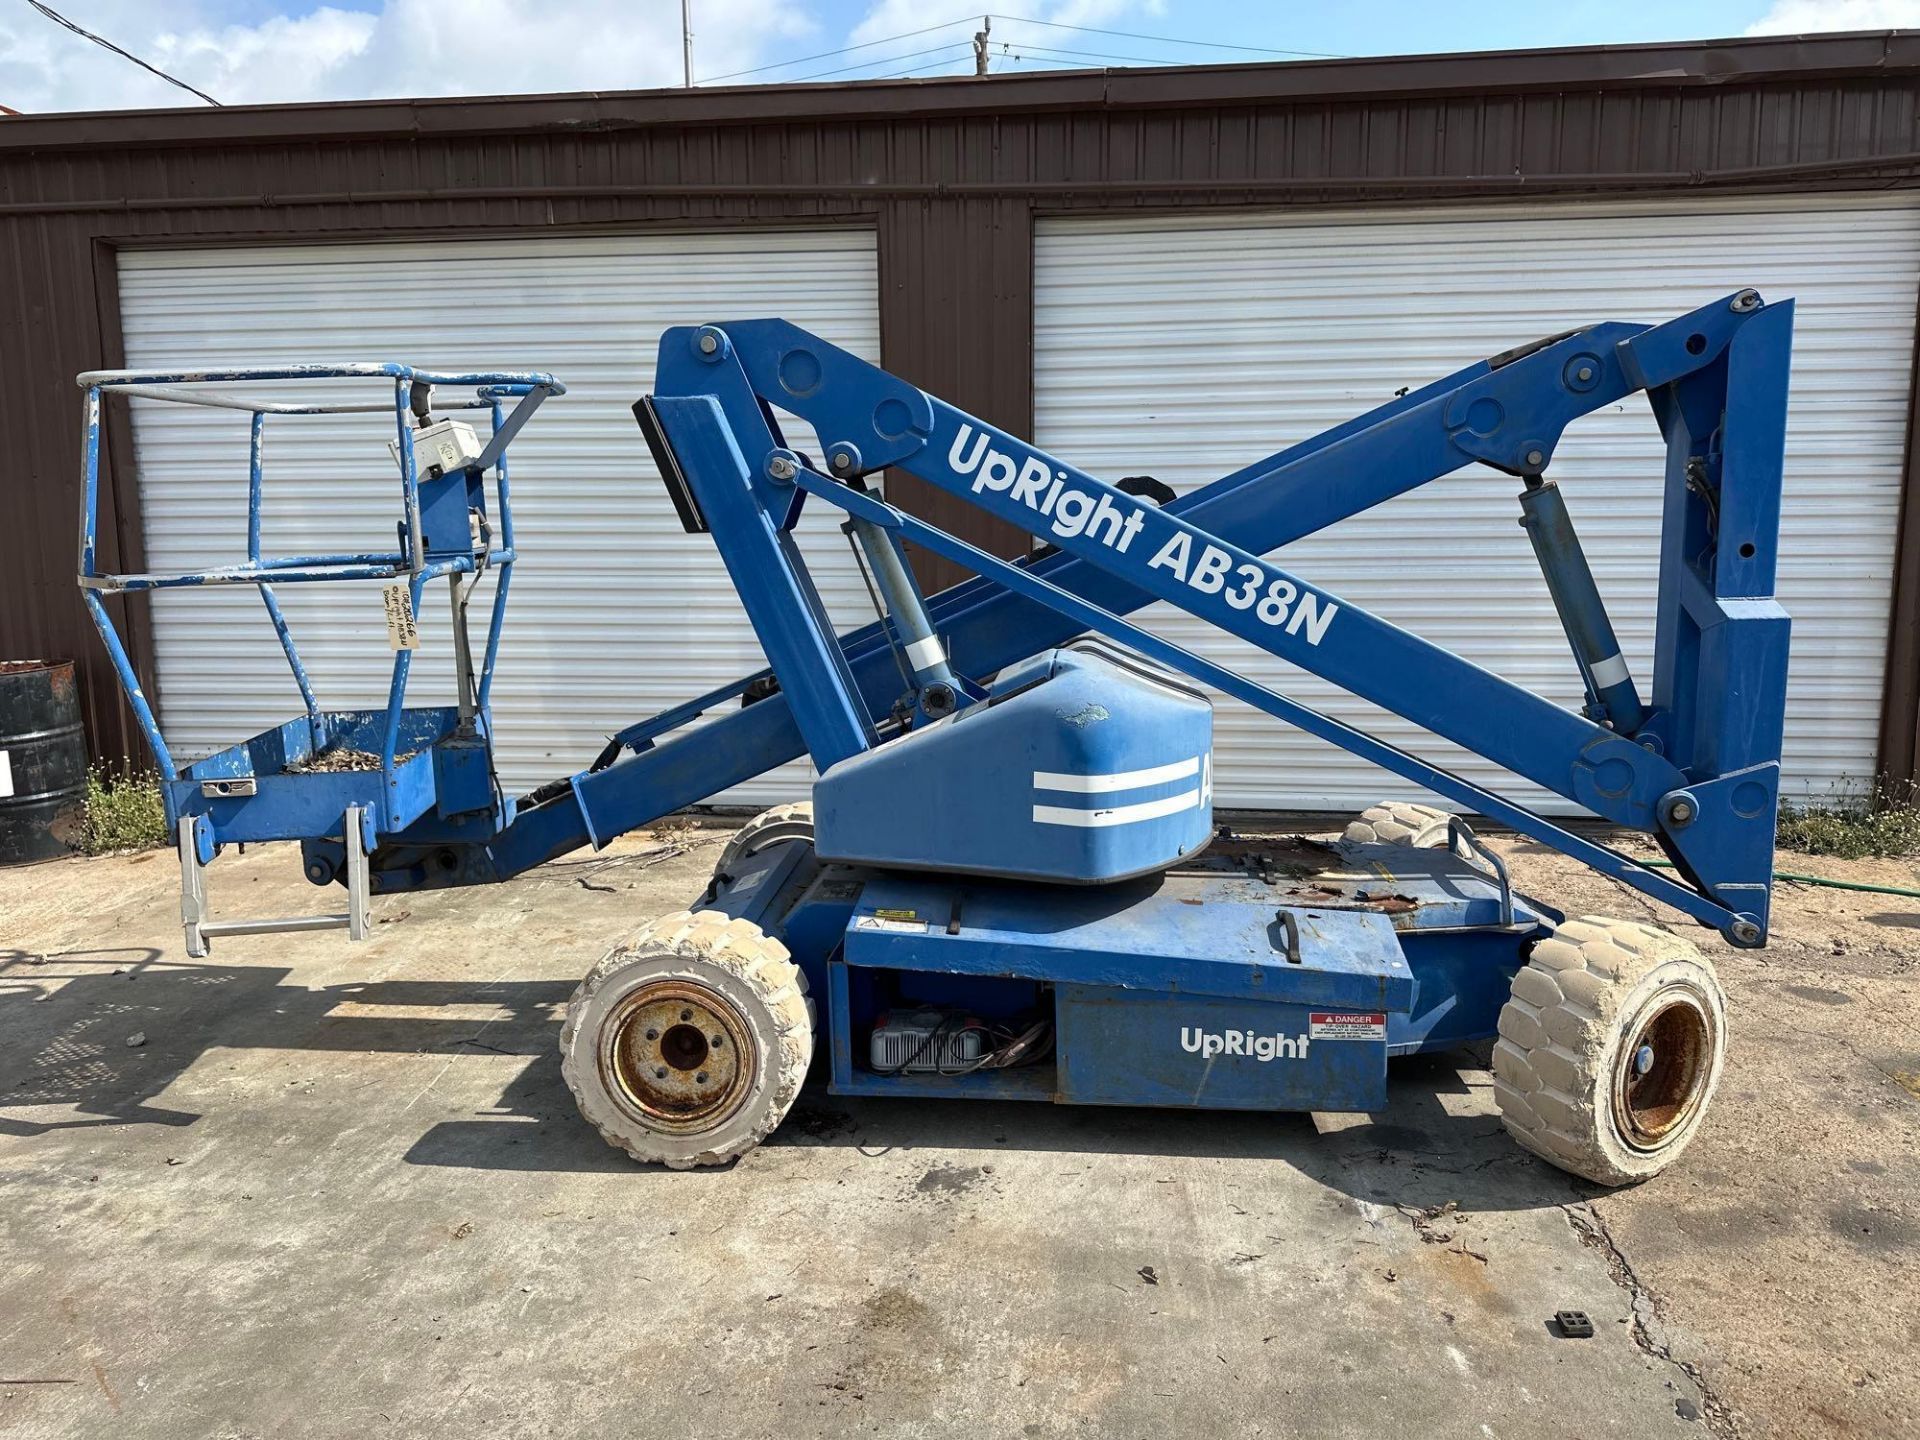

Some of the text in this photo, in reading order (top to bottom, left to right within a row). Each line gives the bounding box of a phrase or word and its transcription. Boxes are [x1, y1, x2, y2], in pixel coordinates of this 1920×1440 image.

[947, 423, 1339, 646] UpRight AB38N
[1181, 1027, 1309, 1061] UpRight
